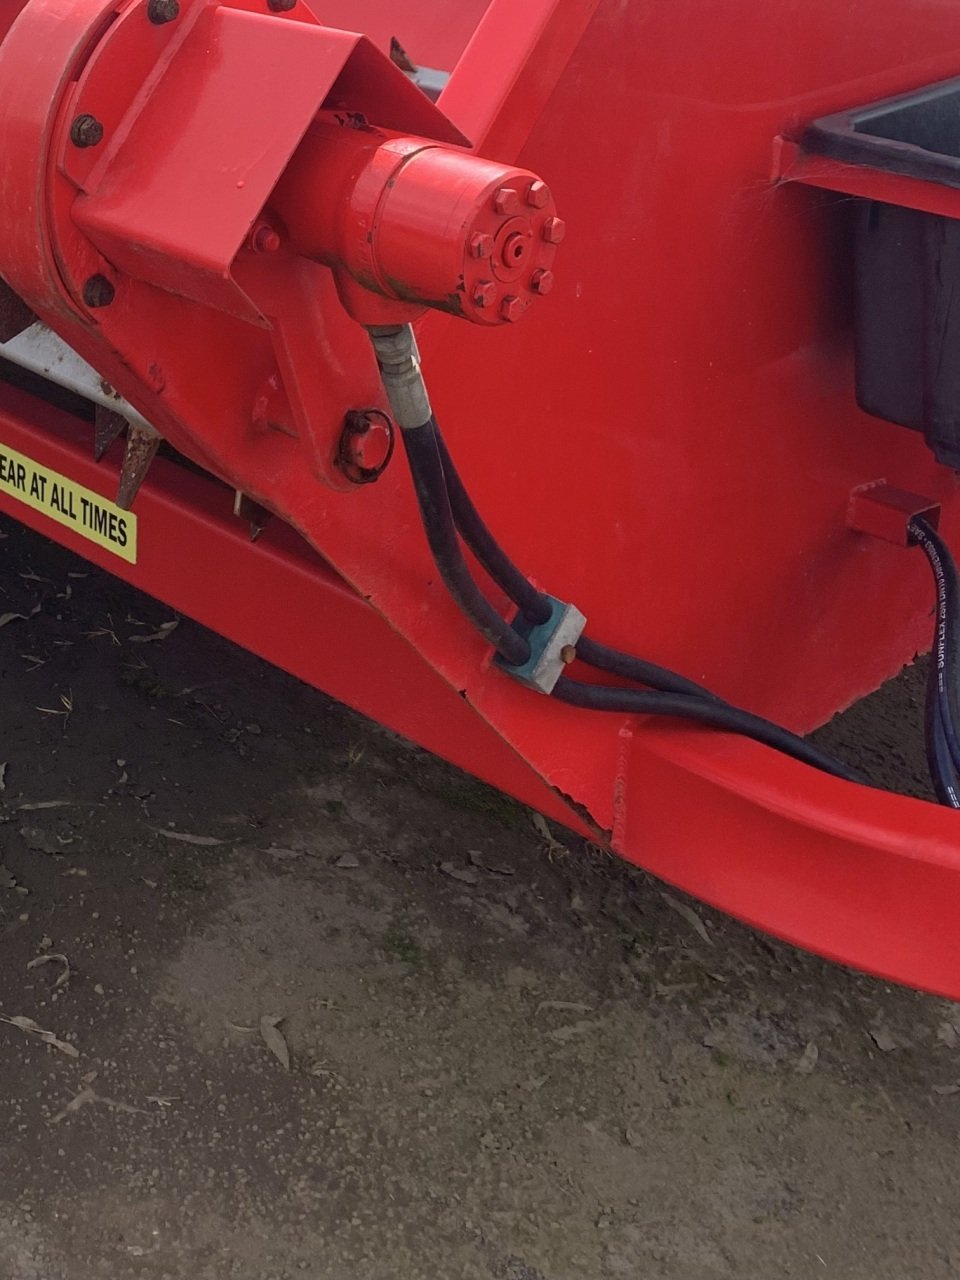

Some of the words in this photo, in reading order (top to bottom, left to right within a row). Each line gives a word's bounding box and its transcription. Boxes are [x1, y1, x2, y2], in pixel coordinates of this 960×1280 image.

[30, 472, 47, 502] AT
[50, 483, 77, 521] ALL
[80, 497, 128, 548] TIMES
